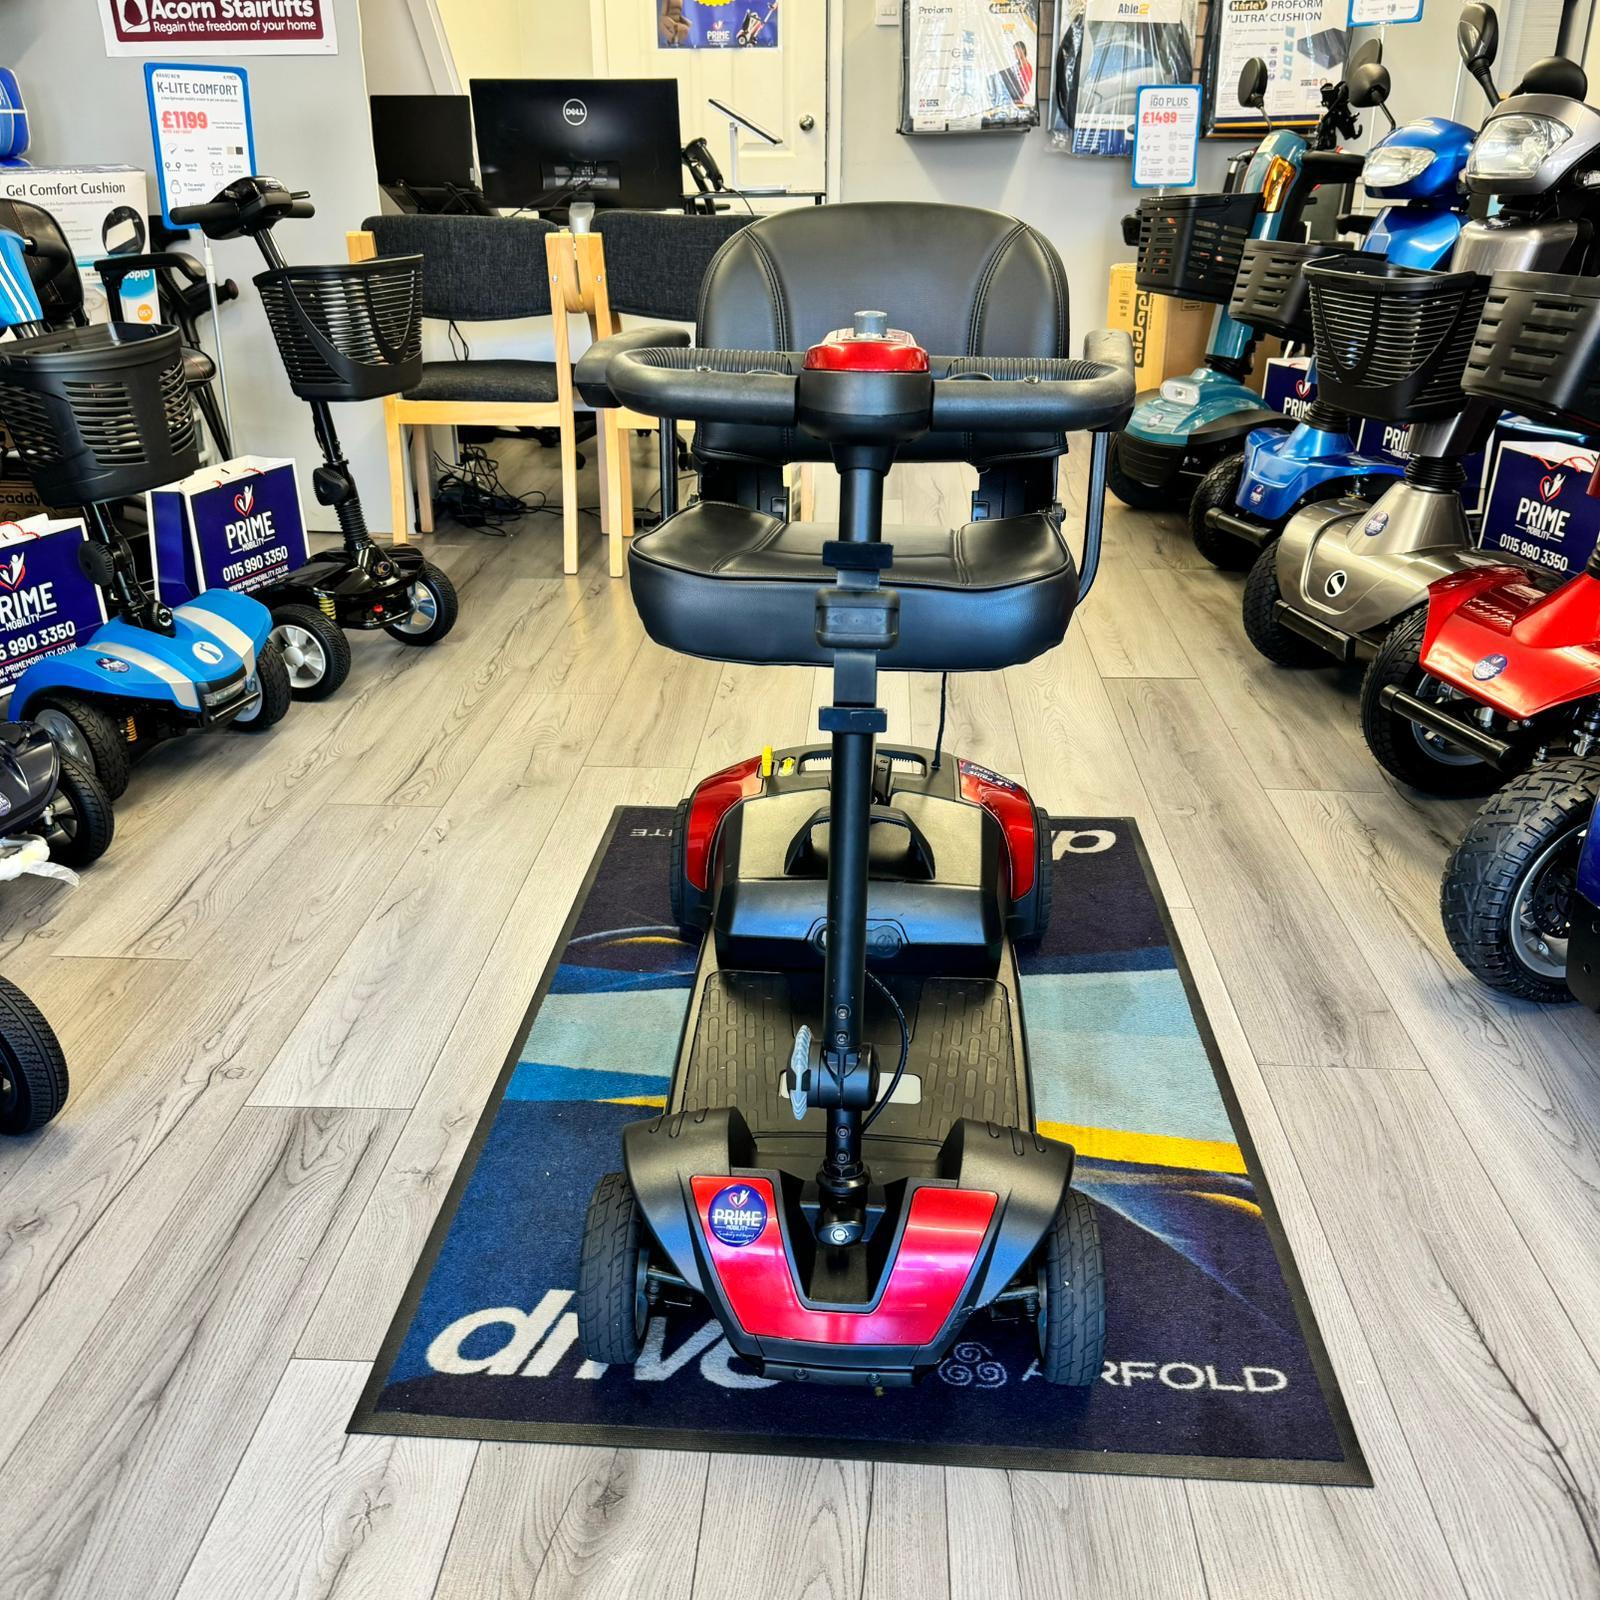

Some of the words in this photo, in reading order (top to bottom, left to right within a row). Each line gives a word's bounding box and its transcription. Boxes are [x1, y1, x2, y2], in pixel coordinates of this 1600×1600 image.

[151, 0, 216, 19] Acorn
[222, 0, 314, 18] Stairlifts
[1271, 0, 1323, 9] PROFORM
[1270, 11, 1322, 22] CUSHION
[154, 21, 187, 34] Regain
[189, 21, 205, 32] the
[207, 20, 249, 32] freedom
[250, 20, 261, 31] of
[262, 21, 285, 33] your
[287, 20, 317, 31] home
[706, 30, 731, 40] PRIME
[156, 81, 191, 94] K-LITE
[192, 83, 239, 96] COMFORT
[1166, 96, 1189, 107] PLUS
[162, 110, 208, 129] £1199
[565, 108, 585, 116] DELL
[1142, 111, 1178, 124] £1499
[6, 184, 26, 197] Gel
[30, 183, 78, 196] Comfort
[80, 181, 126, 195] Cushion
[1134, 291, 1151, 365] aidap
[1283, 396, 1314, 421] PRIM
[1382, 426, 1410, 453] PRI
[1515, 496, 1571, 538] PRIME
[225, 510, 276, 549] PRIME
[1525, 525, 1551, 541] MOBILITY
[241, 537, 265, 552] MOBILITY
[1499, 533, 1521, 553] 0115
[1519, 541, 1541, 561] 990
[1540, 549, 1569, 572] 3350
[222, 561, 245, 582] 0115
[244, 554, 264, 573] 990
[263, 545, 289, 566] 3350
[0, 581, 58, 625] RIME
[5, 613, 41, 632] MOBILITY
[8, 633, 38, 657] 990
[38, 620, 77, 646] 3350
[629, 828, 673, 837] ITE
[713, 1208, 762, 1228] PRIME
[425, 1288, 783, 1390] drv
[1021, 1358, 1289, 1393] ARFOLD
